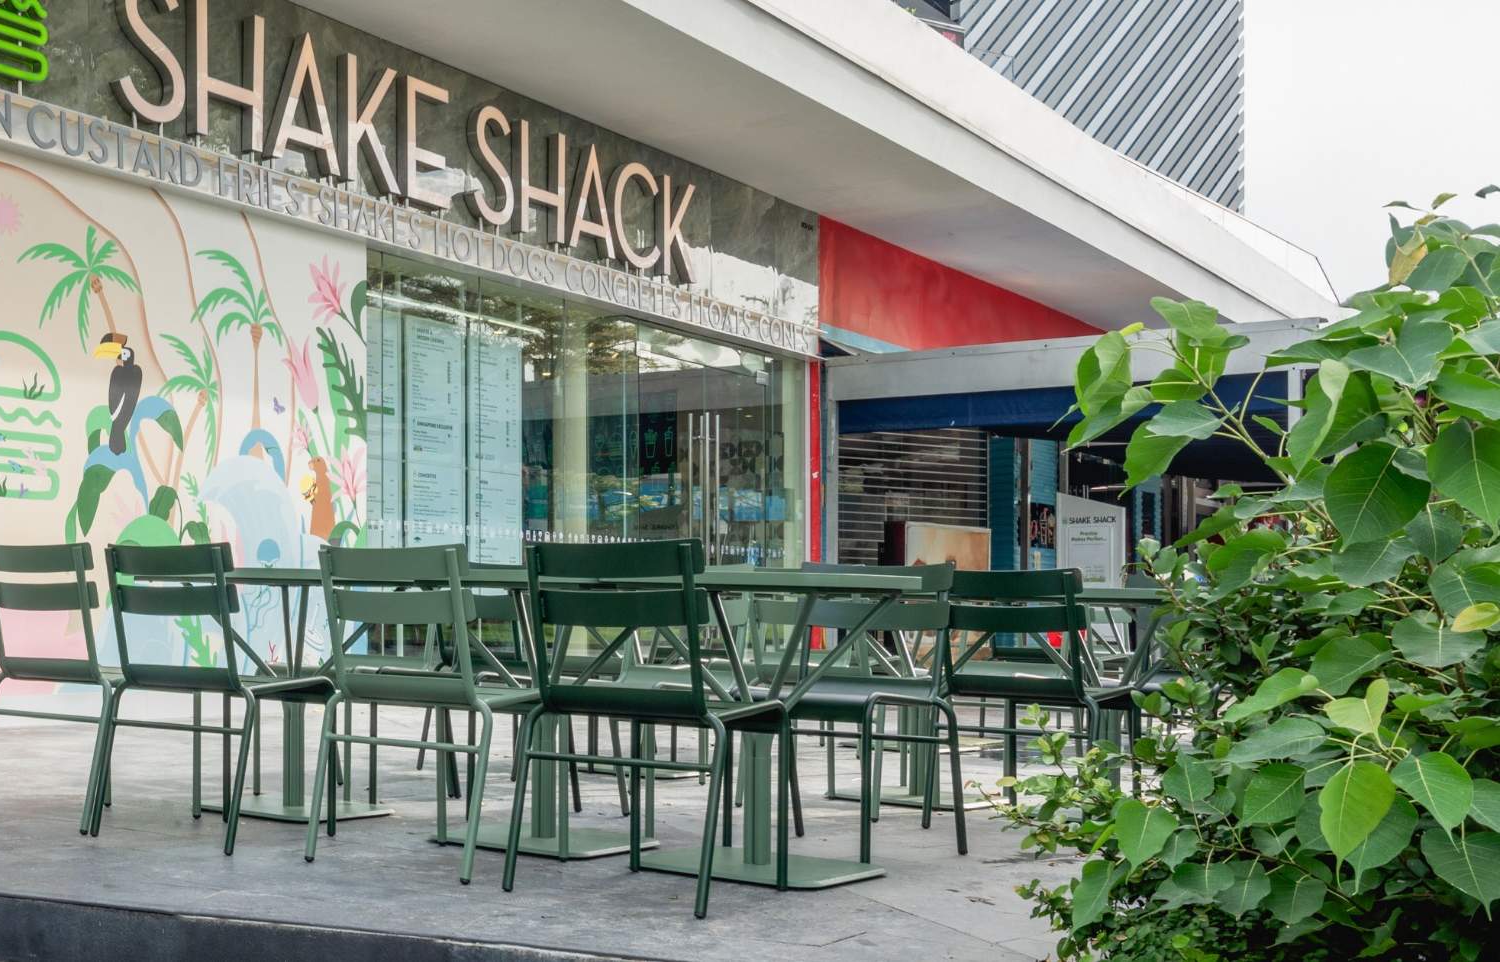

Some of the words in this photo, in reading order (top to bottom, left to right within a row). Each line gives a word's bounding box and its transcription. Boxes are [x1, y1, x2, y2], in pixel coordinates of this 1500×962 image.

[26, 104, 202, 187] CUSTARD
[218, 156, 301, 216] FRIES
[318, 186, 421, 250] SHAKES
[435, 220, 484, 266] HOT
[492, 236, 556, 285] DOGS
[564, 261, 682, 318] CONCRETES
[758, 315, 810, 354] CONES
[111, 0, 449, 210] SHAKE
[465, 104, 696, 285] SHACK
[1069, 516, 1091, 524] SHAKE
[1093, 515, 1116, 523] SHACK
